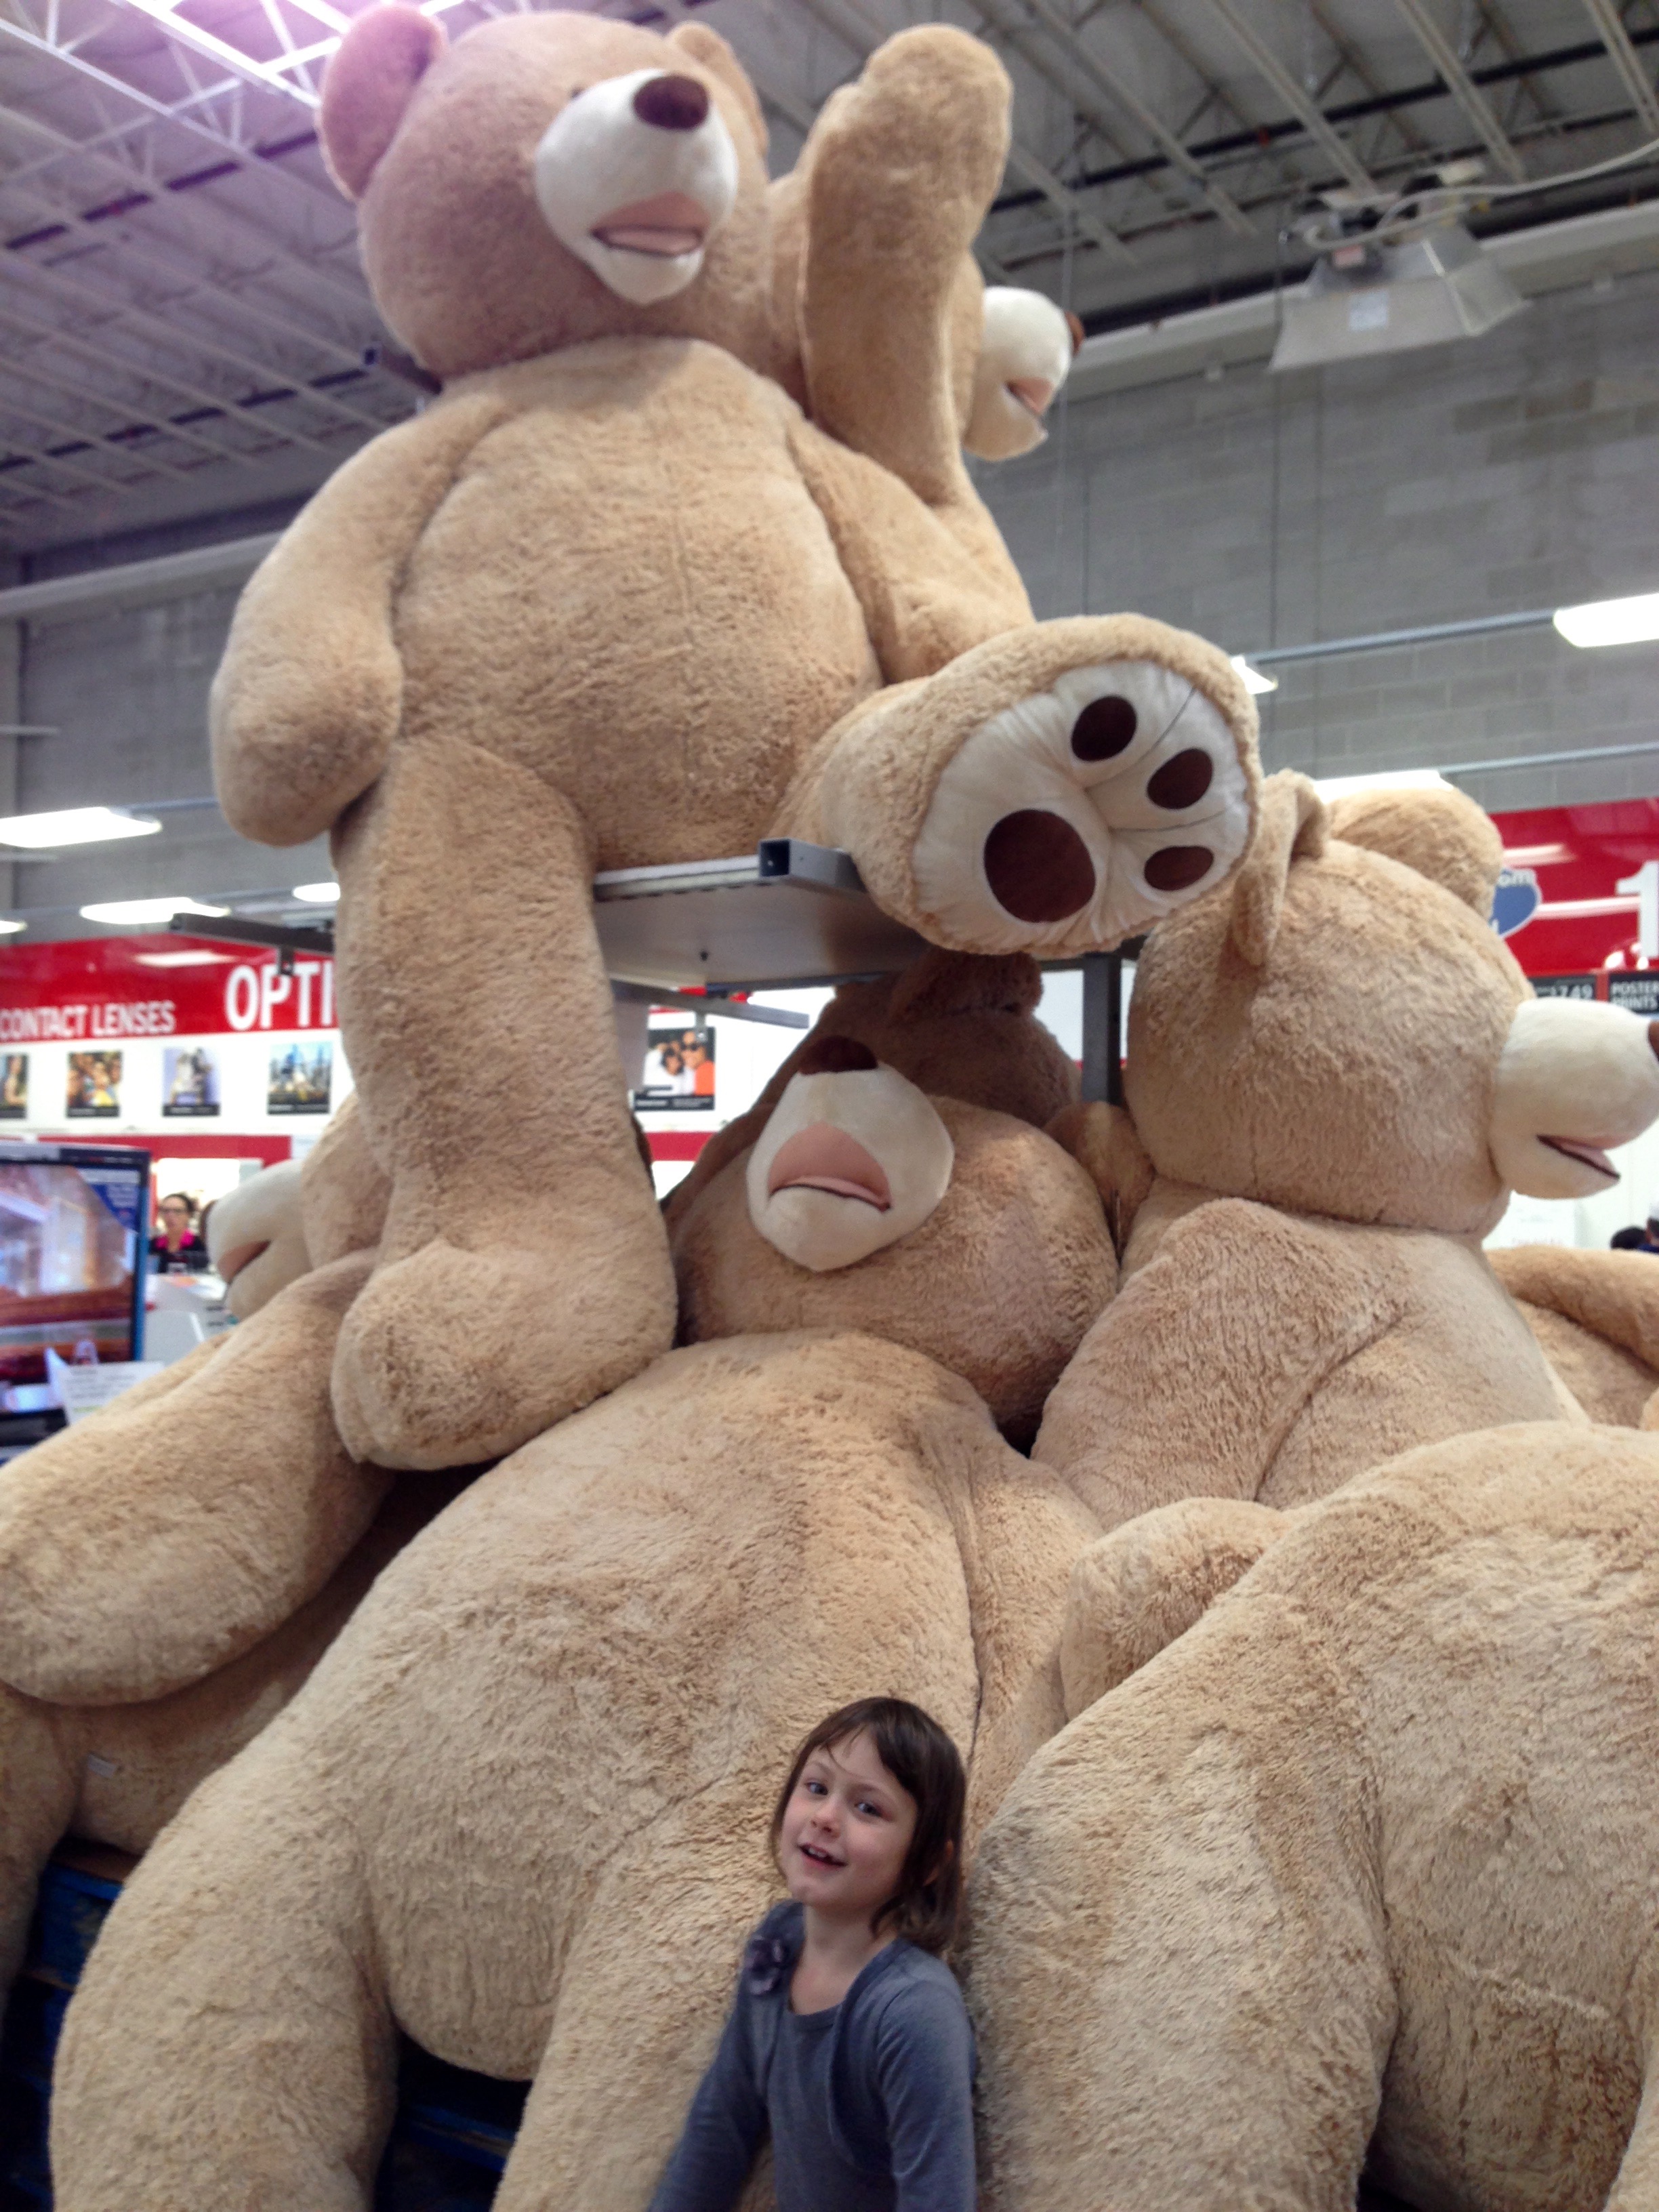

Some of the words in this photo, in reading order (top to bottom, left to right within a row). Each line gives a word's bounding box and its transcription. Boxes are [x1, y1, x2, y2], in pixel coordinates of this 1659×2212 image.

[0, 1006, 88, 1039] CONTACT
[91, 1000, 176, 1036] LENSES
[225, 962, 333, 1031] OPTI
